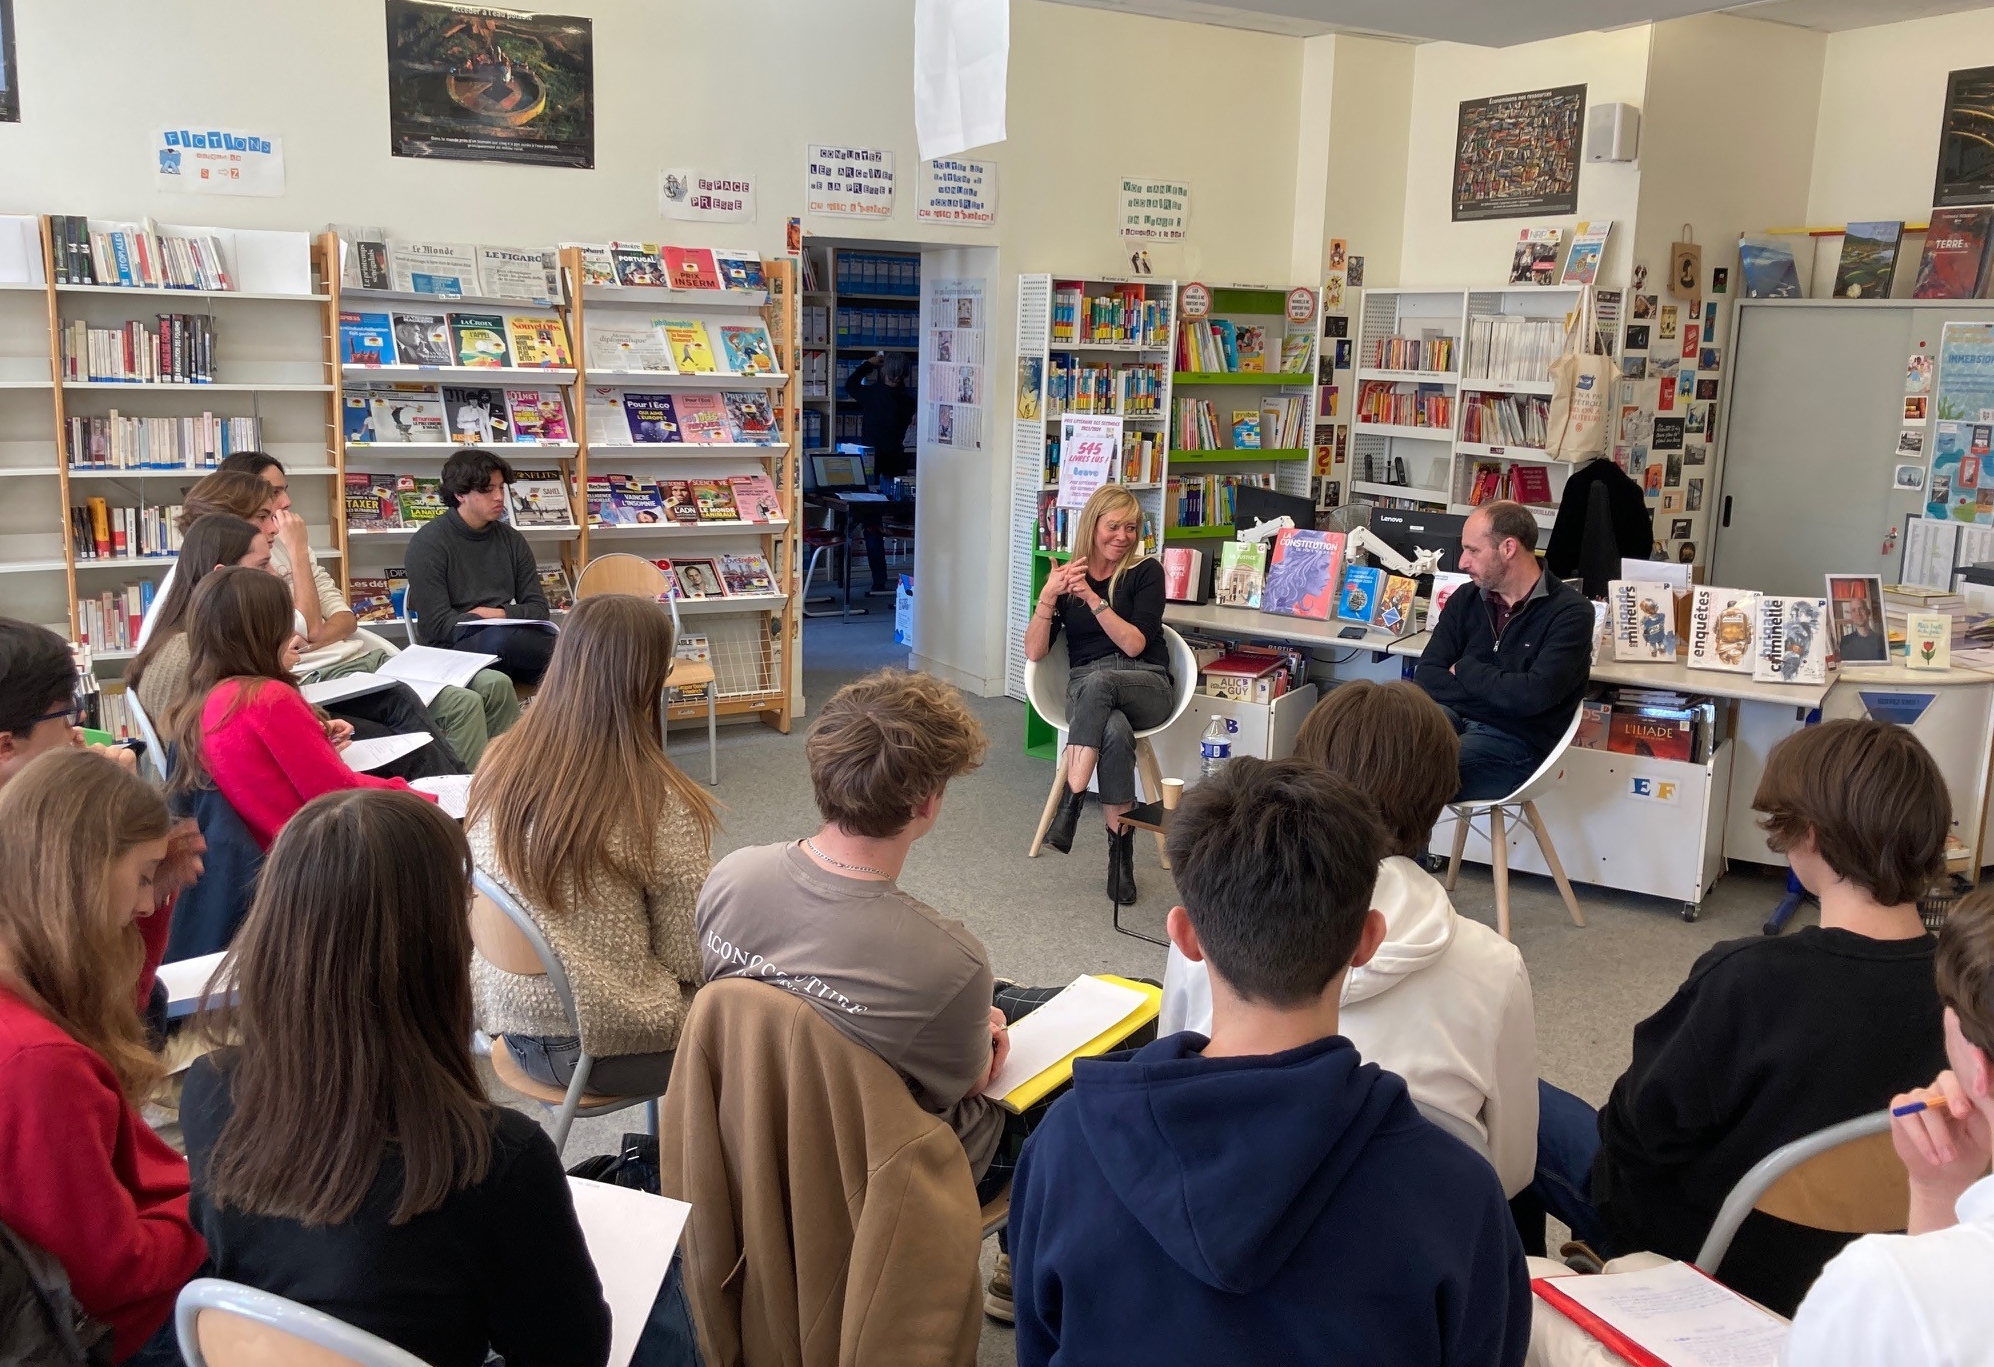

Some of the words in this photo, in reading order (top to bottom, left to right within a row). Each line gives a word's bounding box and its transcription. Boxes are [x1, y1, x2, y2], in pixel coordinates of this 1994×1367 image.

[164, 131, 271, 154] FICTIONS
[820, 149, 882, 162] CONSULTEZ
[201, 168, 209, 179] S
[231, 168, 239, 179] Z
[811, 164, 832, 176] LES
[699, 179, 750, 192] ESPACE
[828, 182, 841, 191] LA
[690, 197, 742, 210] PRESSE
[115, 232, 130, 273] UTOPIALES
[412, 245, 420, 253] Le
[422, 246, 454, 255] Monde
[485, 251, 500, 259] LE
[500, 252, 542, 263] FIGARO
[618, 255, 657, 263] PORTUGAL
[680, 272, 700, 280] PRIX
[675, 278, 716, 288] INSERM
[1078, 442, 1103, 455] 545
[1068, 455, 1091, 463] LIVRES
[347, 500, 379, 509] TAXER
[1380, 515, 1403, 523] Lenovo
[1280, 538, 1338, 551] CONSTITUTION
[1618, 586, 1628, 641] brigade
[1628, 585, 1638, 641] mineurs
[1694, 590, 1710, 658] enquêtes
[1221, 677, 1241, 687] ALIC
[1228, 687, 1249, 696] GUY
[1224, 718, 1239, 734] B
[1625, 724, 1673, 739] L'ILIADE
[1631, 777, 1651, 796] E
[1656, 782, 1676, 800] F
